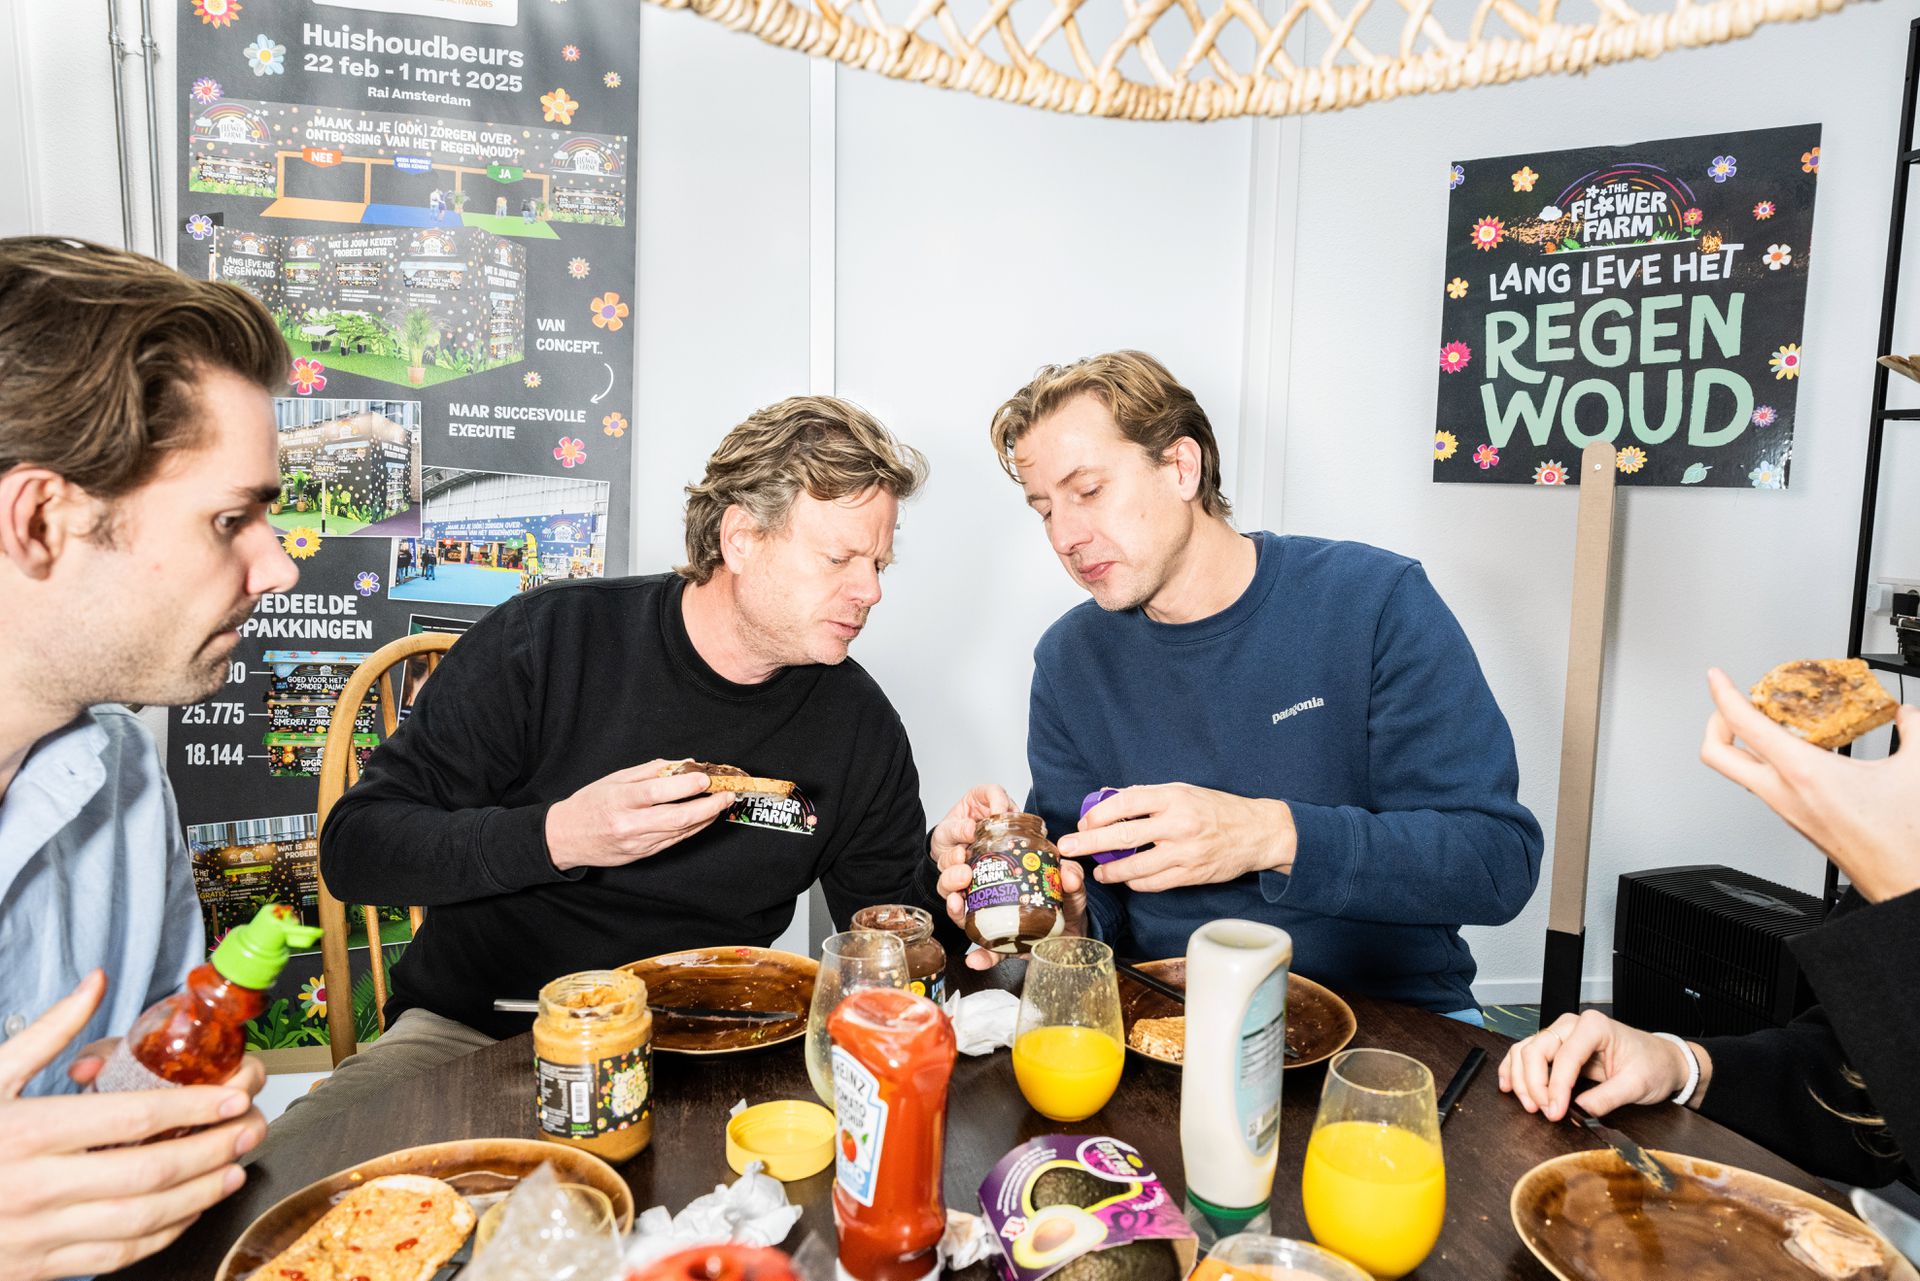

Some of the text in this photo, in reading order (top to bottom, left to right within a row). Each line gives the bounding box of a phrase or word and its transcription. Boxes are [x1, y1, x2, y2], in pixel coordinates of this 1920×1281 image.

[303, 23, 524, 68] Huishoudbeurs
[304, 53, 333, 74] 22
[339, 56, 379, 78] feb
[399, 63, 409, 81] 1
[416, 68, 460, 86] mrt
[466, 71, 523, 93] 2025
[368, 87, 471, 107] Rai Amsterdam
[314, 116, 353, 131] MAAK
[356, 119, 373, 133] JIJ
[377, 121, 391, 134] JE
[430, 125, 478, 144] ZORGEN
[480, 132, 512, 146] OVER
[305, 128, 521, 159] ONTBOSSING VAN HET REGENWOUD?
[311, 151, 334, 164] NEE
[498, 169, 511, 180] JA
[1607, 183, 1629, 193] THE
[1583, 215, 1654, 243] FARM
[222, 264, 276, 278] REGENWOUD
[223, 255, 244, 267] LANG
[244, 258, 262, 269] LEVE
[1489, 243, 1744, 302] LANG LEVE HET
[536, 318, 565, 332] VAN
[1485, 292, 1746, 385] REGEN
[449, 403, 586, 424] NAAR SUCCESVOLLE
[1480, 367, 1755, 450] WOUD
[449, 424, 515, 440] EXECUTIE
[255, 593, 358, 615] EDEELDE
[182, 703, 245, 724] 25.775
[1272, 697, 1325, 725] patagonia
[273, 718, 307, 727] SMEREN
[185, 743, 244, 765] 18.144
[301, 759, 322, 767] OPGR
[751, 808, 792, 826] FARM
[977, 870, 1005, 885] FARM
[968, 884, 1019, 906] DUOPASTA
